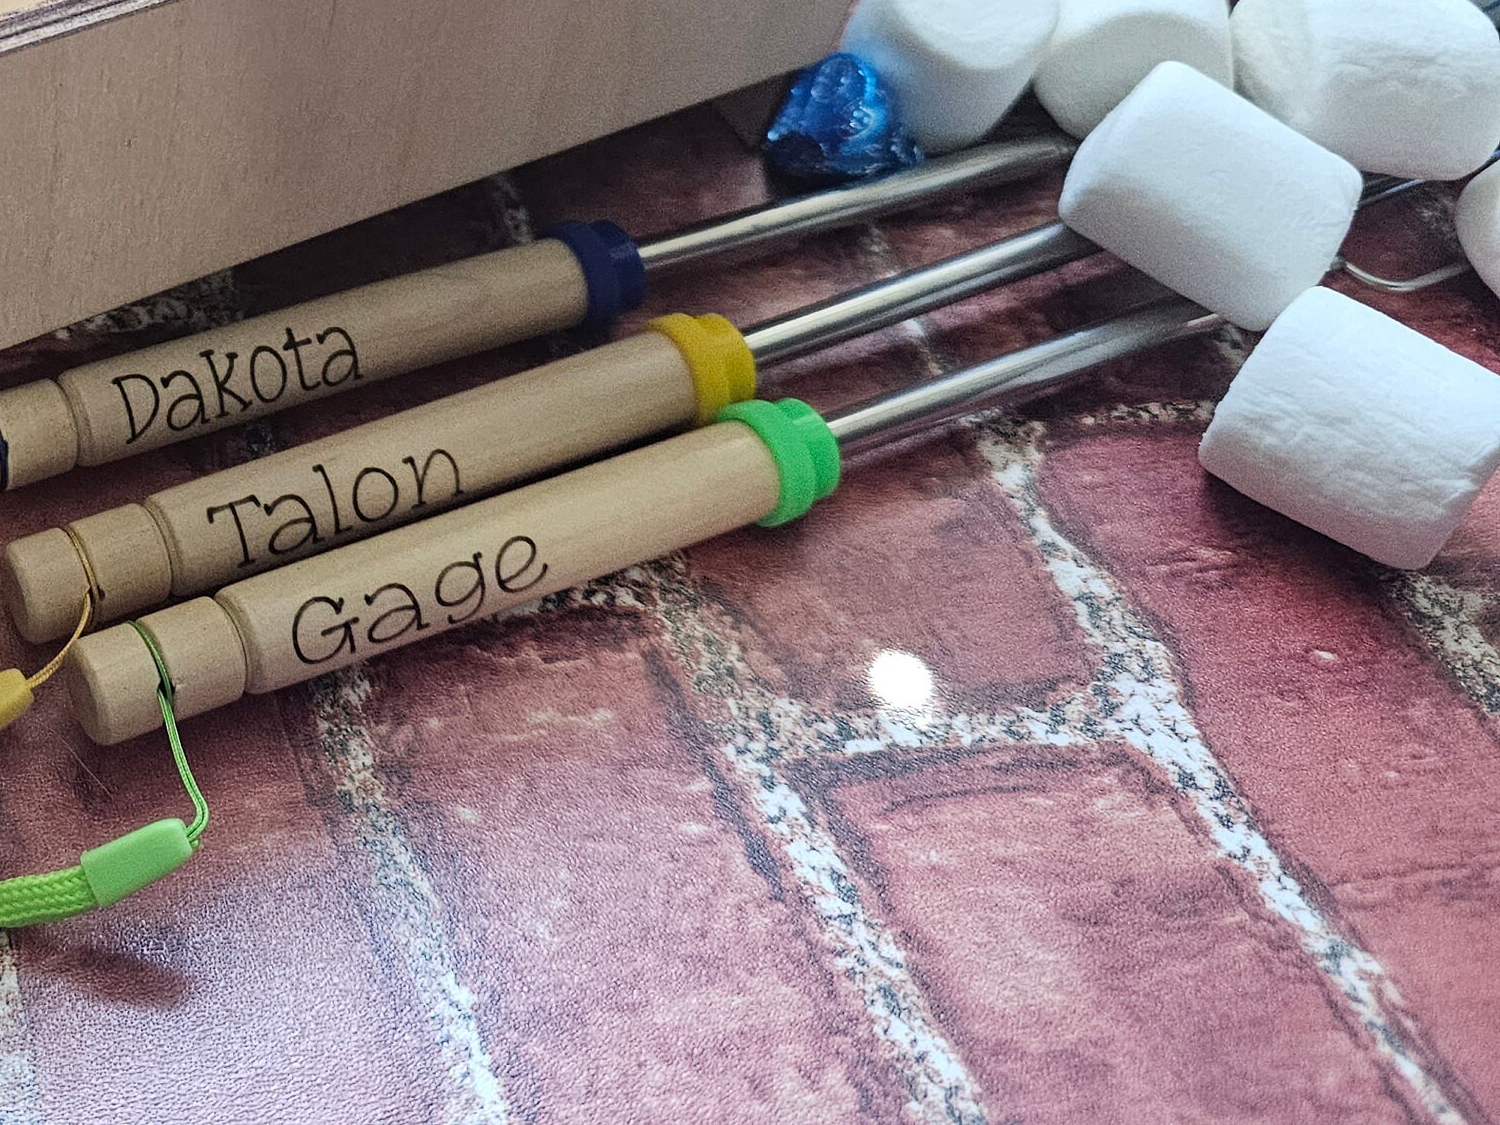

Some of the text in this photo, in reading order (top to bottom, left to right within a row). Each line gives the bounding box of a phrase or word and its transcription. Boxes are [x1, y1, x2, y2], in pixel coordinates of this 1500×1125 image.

[112, 323, 364, 445] Dakota
[207, 446, 464, 572] Talon
[291, 533, 549, 666] Gage
